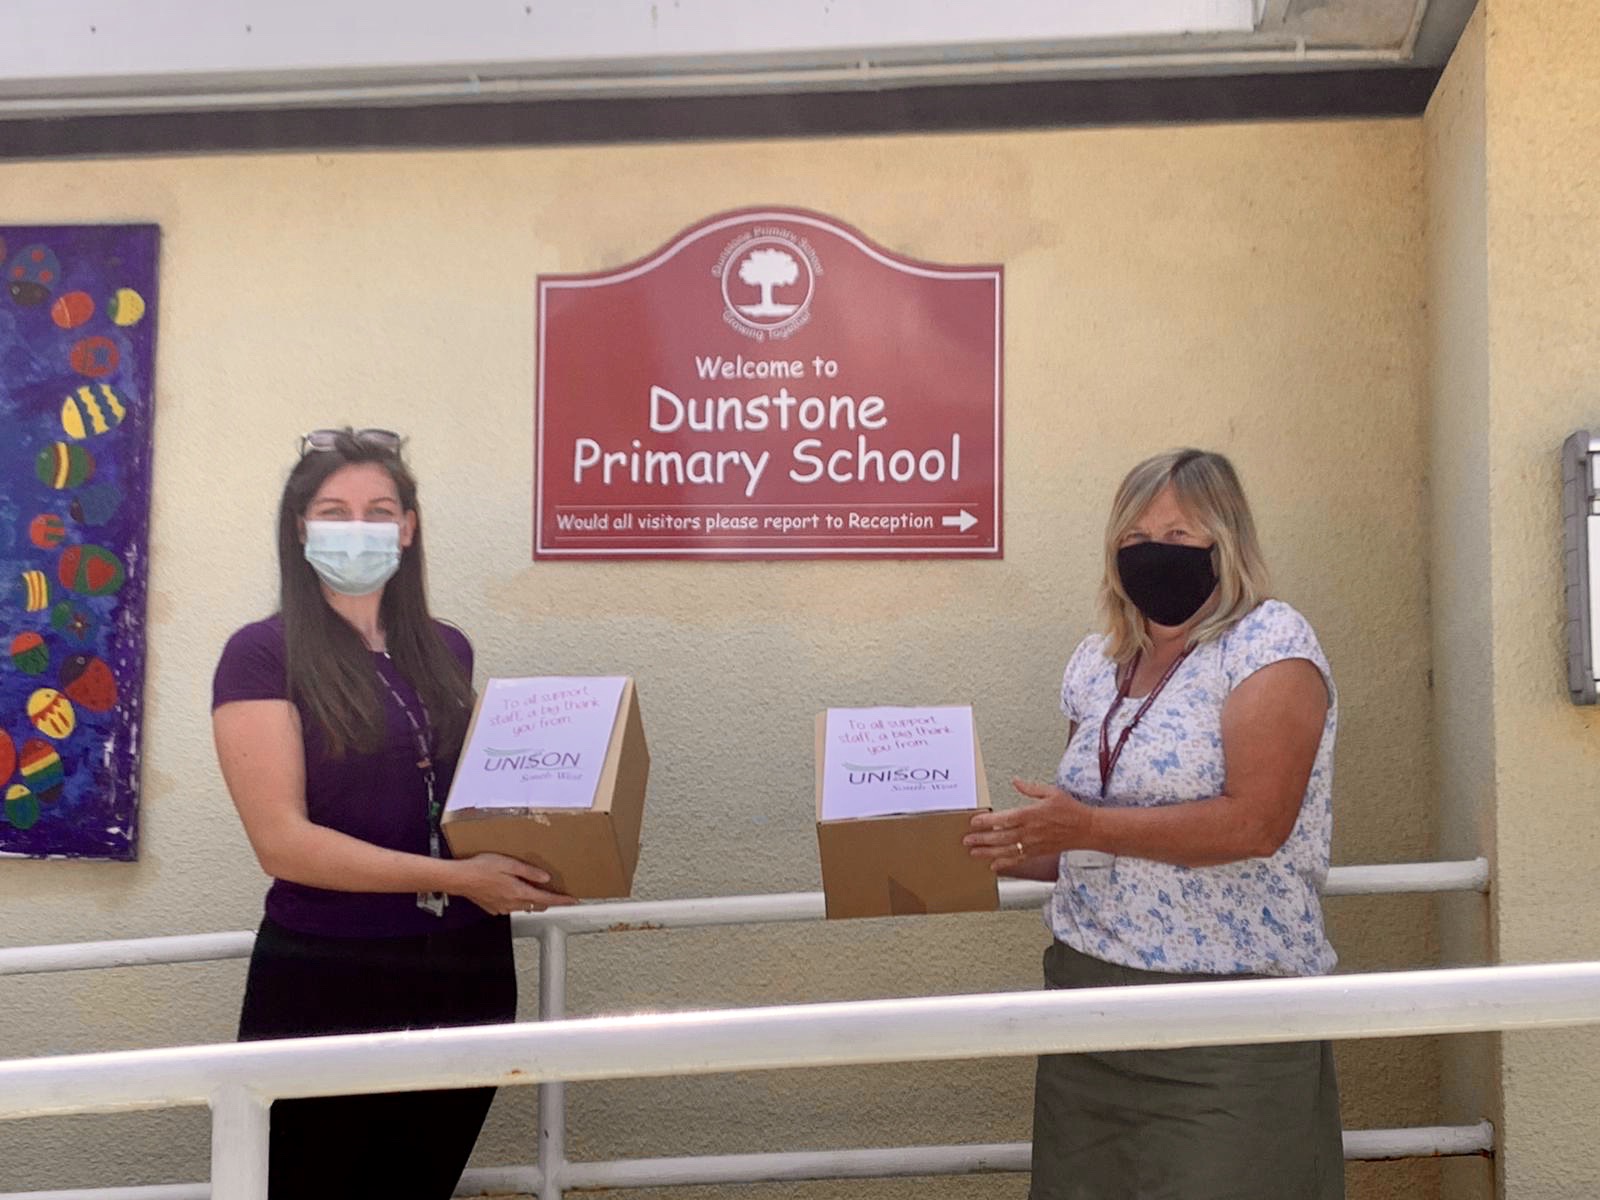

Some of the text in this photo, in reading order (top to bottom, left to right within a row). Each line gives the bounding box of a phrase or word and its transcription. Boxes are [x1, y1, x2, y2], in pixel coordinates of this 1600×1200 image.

[696, 355, 838, 379] Welcome to
[649, 385, 888, 432] Dunstone
[573, 433, 961, 497] Primary School
[556, 512, 934, 533] Would all visitors please report to Reception
[503, 685, 589, 711] To all support
[527, 709, 537, 719] a
[540, 702, 560, 717] big
[564, 697, 600, 711] thank
[512, 724, 536, 738] you
[849, 716, 937, 730] To all support
[878, 732, 888, 741] a
[892, 729, 913, 740] big
[916, 725, 953, 737] thank
[867, 744, 891, 756] you
[484, 752, 581, 772] UNISON
[849, 768, 949, 785] UNISON
